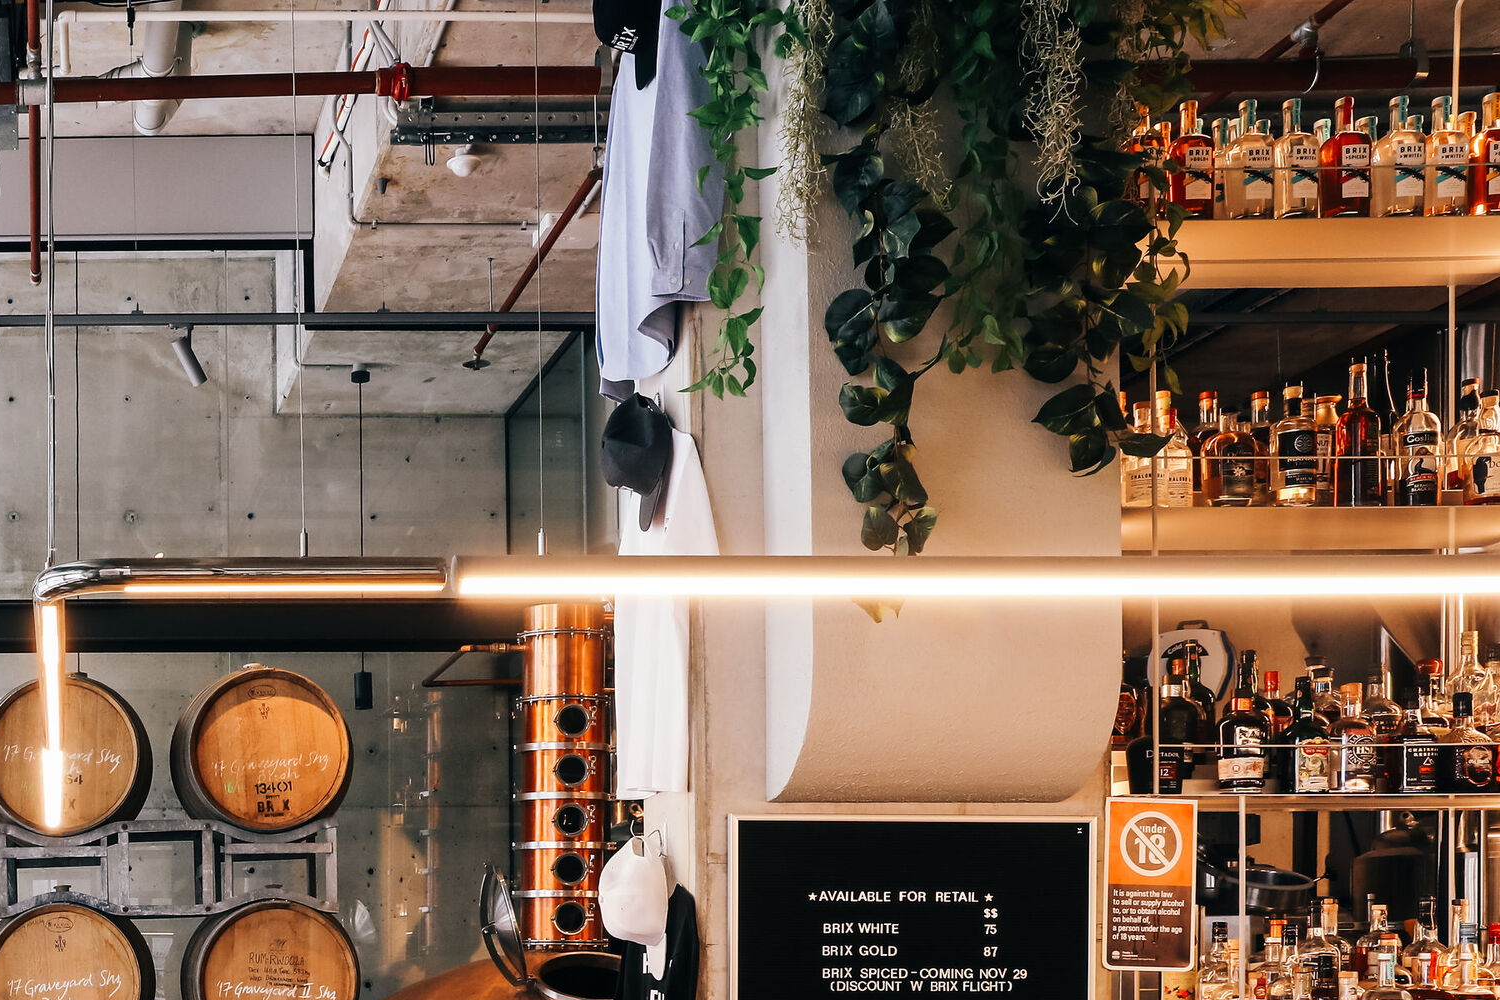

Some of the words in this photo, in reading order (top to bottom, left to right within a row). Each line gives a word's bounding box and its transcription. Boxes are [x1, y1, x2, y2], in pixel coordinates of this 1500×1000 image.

[255, 781, 293, 795] 13401
[1134, 834, 1166, 865] 18
[819, 891, 891, 902] AVAILABLE
[899, 891, 927, 902] FOR
[935, 891, 979, 902] RETAIL
[1141, 900, 1161, 908] supply
[983, 908, 999, 919] $$
[1158, 908, 1181, 916] alcohol
[1142, 916, 1150, 924] of,
[823, 923, 853, 934] BRIX
[858, 923, 899, 934] WHITE
[984, 924, 998, 935] 75
[1141, 925, 1159, 933] under
[1171, 927, 1183, 935] age
[1128, 934, 1147, 942] years.
[822, 945, 853, 956] BRIX
[859, 945, 898, 957] GOLD
[983, 946, 998, 957] 87
[822, 968, 852, 979] BRIX
[980, 968, 1008, 979] NOV
[1013, 969, 1028, 980] 29
[24, 973, 94, 1000] Graveyard
[830, 981, 902, 992] (DISCOUNT
[910, 981, 923, 992] W
[930, 981, 958, 992] BRIX
[963, 981, 1013, 992] FLIGHT)
